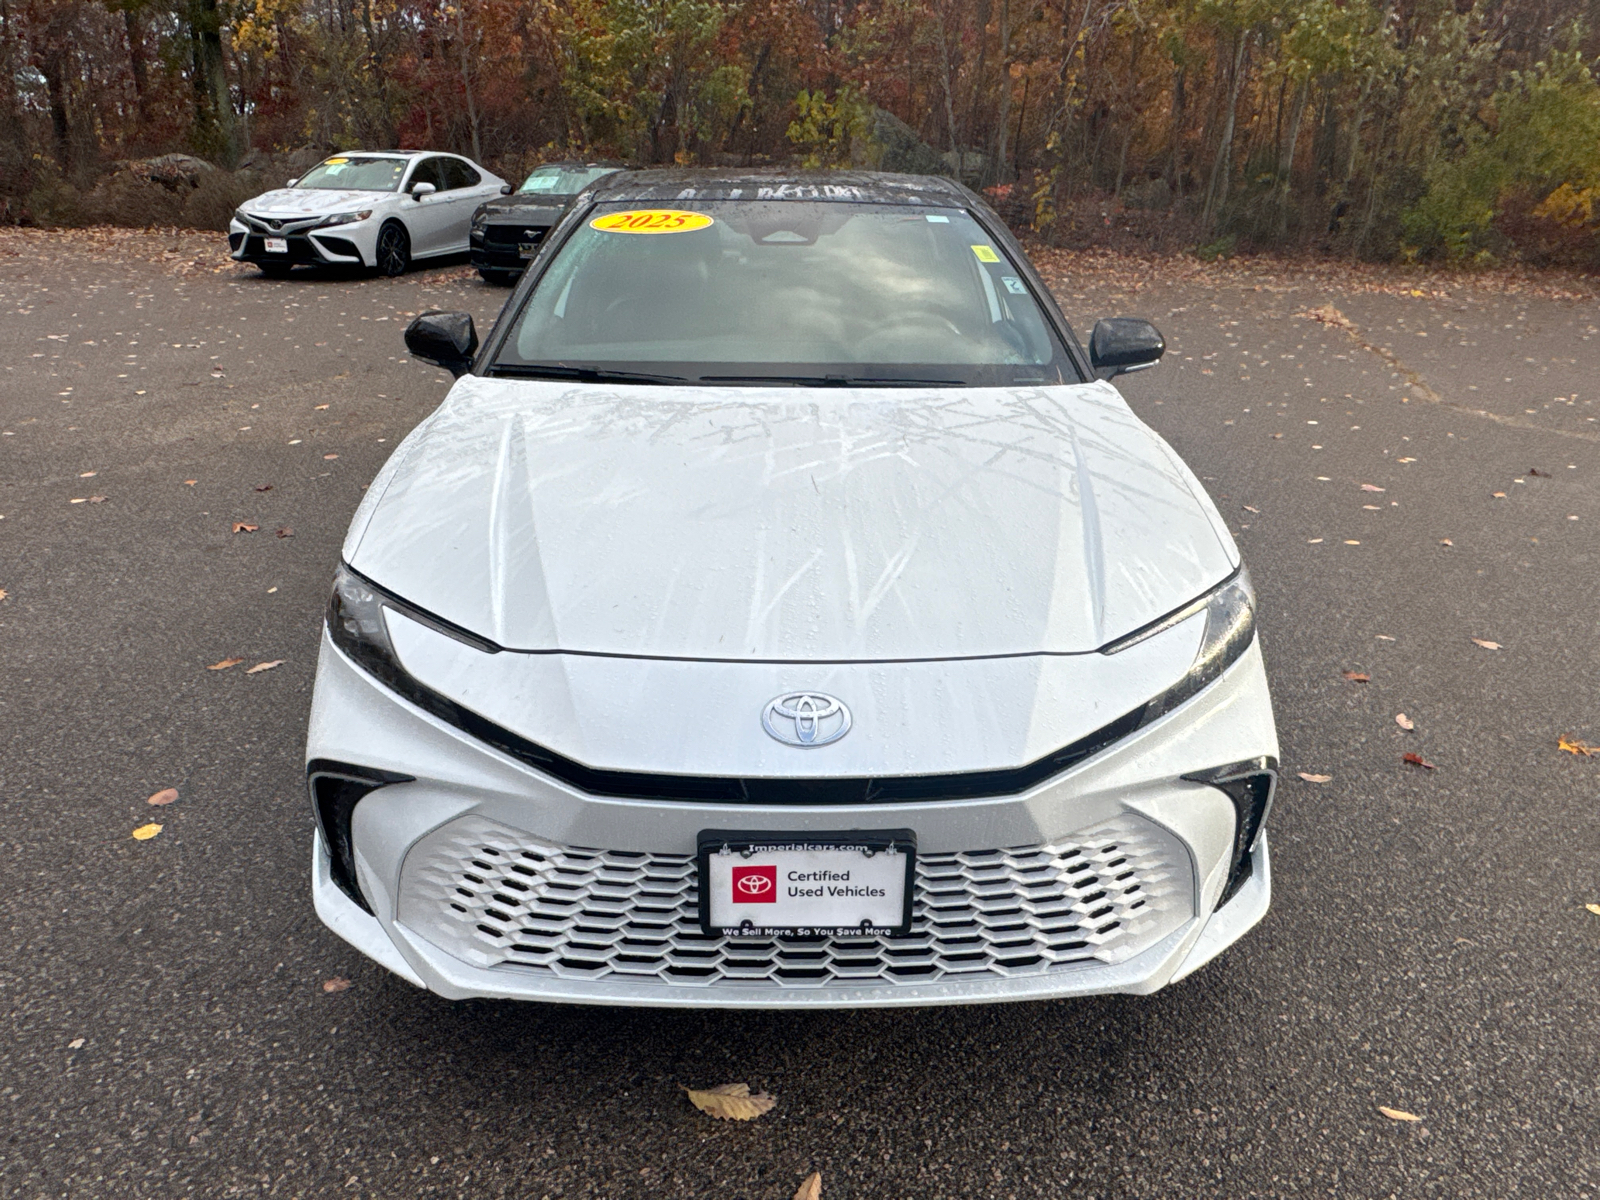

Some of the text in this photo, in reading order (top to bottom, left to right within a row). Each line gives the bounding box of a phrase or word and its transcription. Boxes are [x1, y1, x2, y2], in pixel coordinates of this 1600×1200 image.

[606, 214, 693, 229] 2025
[787, 870, 850, 881] Certified
[788, 885, 886, 897] Used Vehicles
[722, 928, 739, 936] We
[742, 928, 761, 936] Sell
[764, 928, 794, 937] More,
[797, 928, 811, 936] So
[814, 928, 834, 936] You
[836, 928, 862, 936] Save
